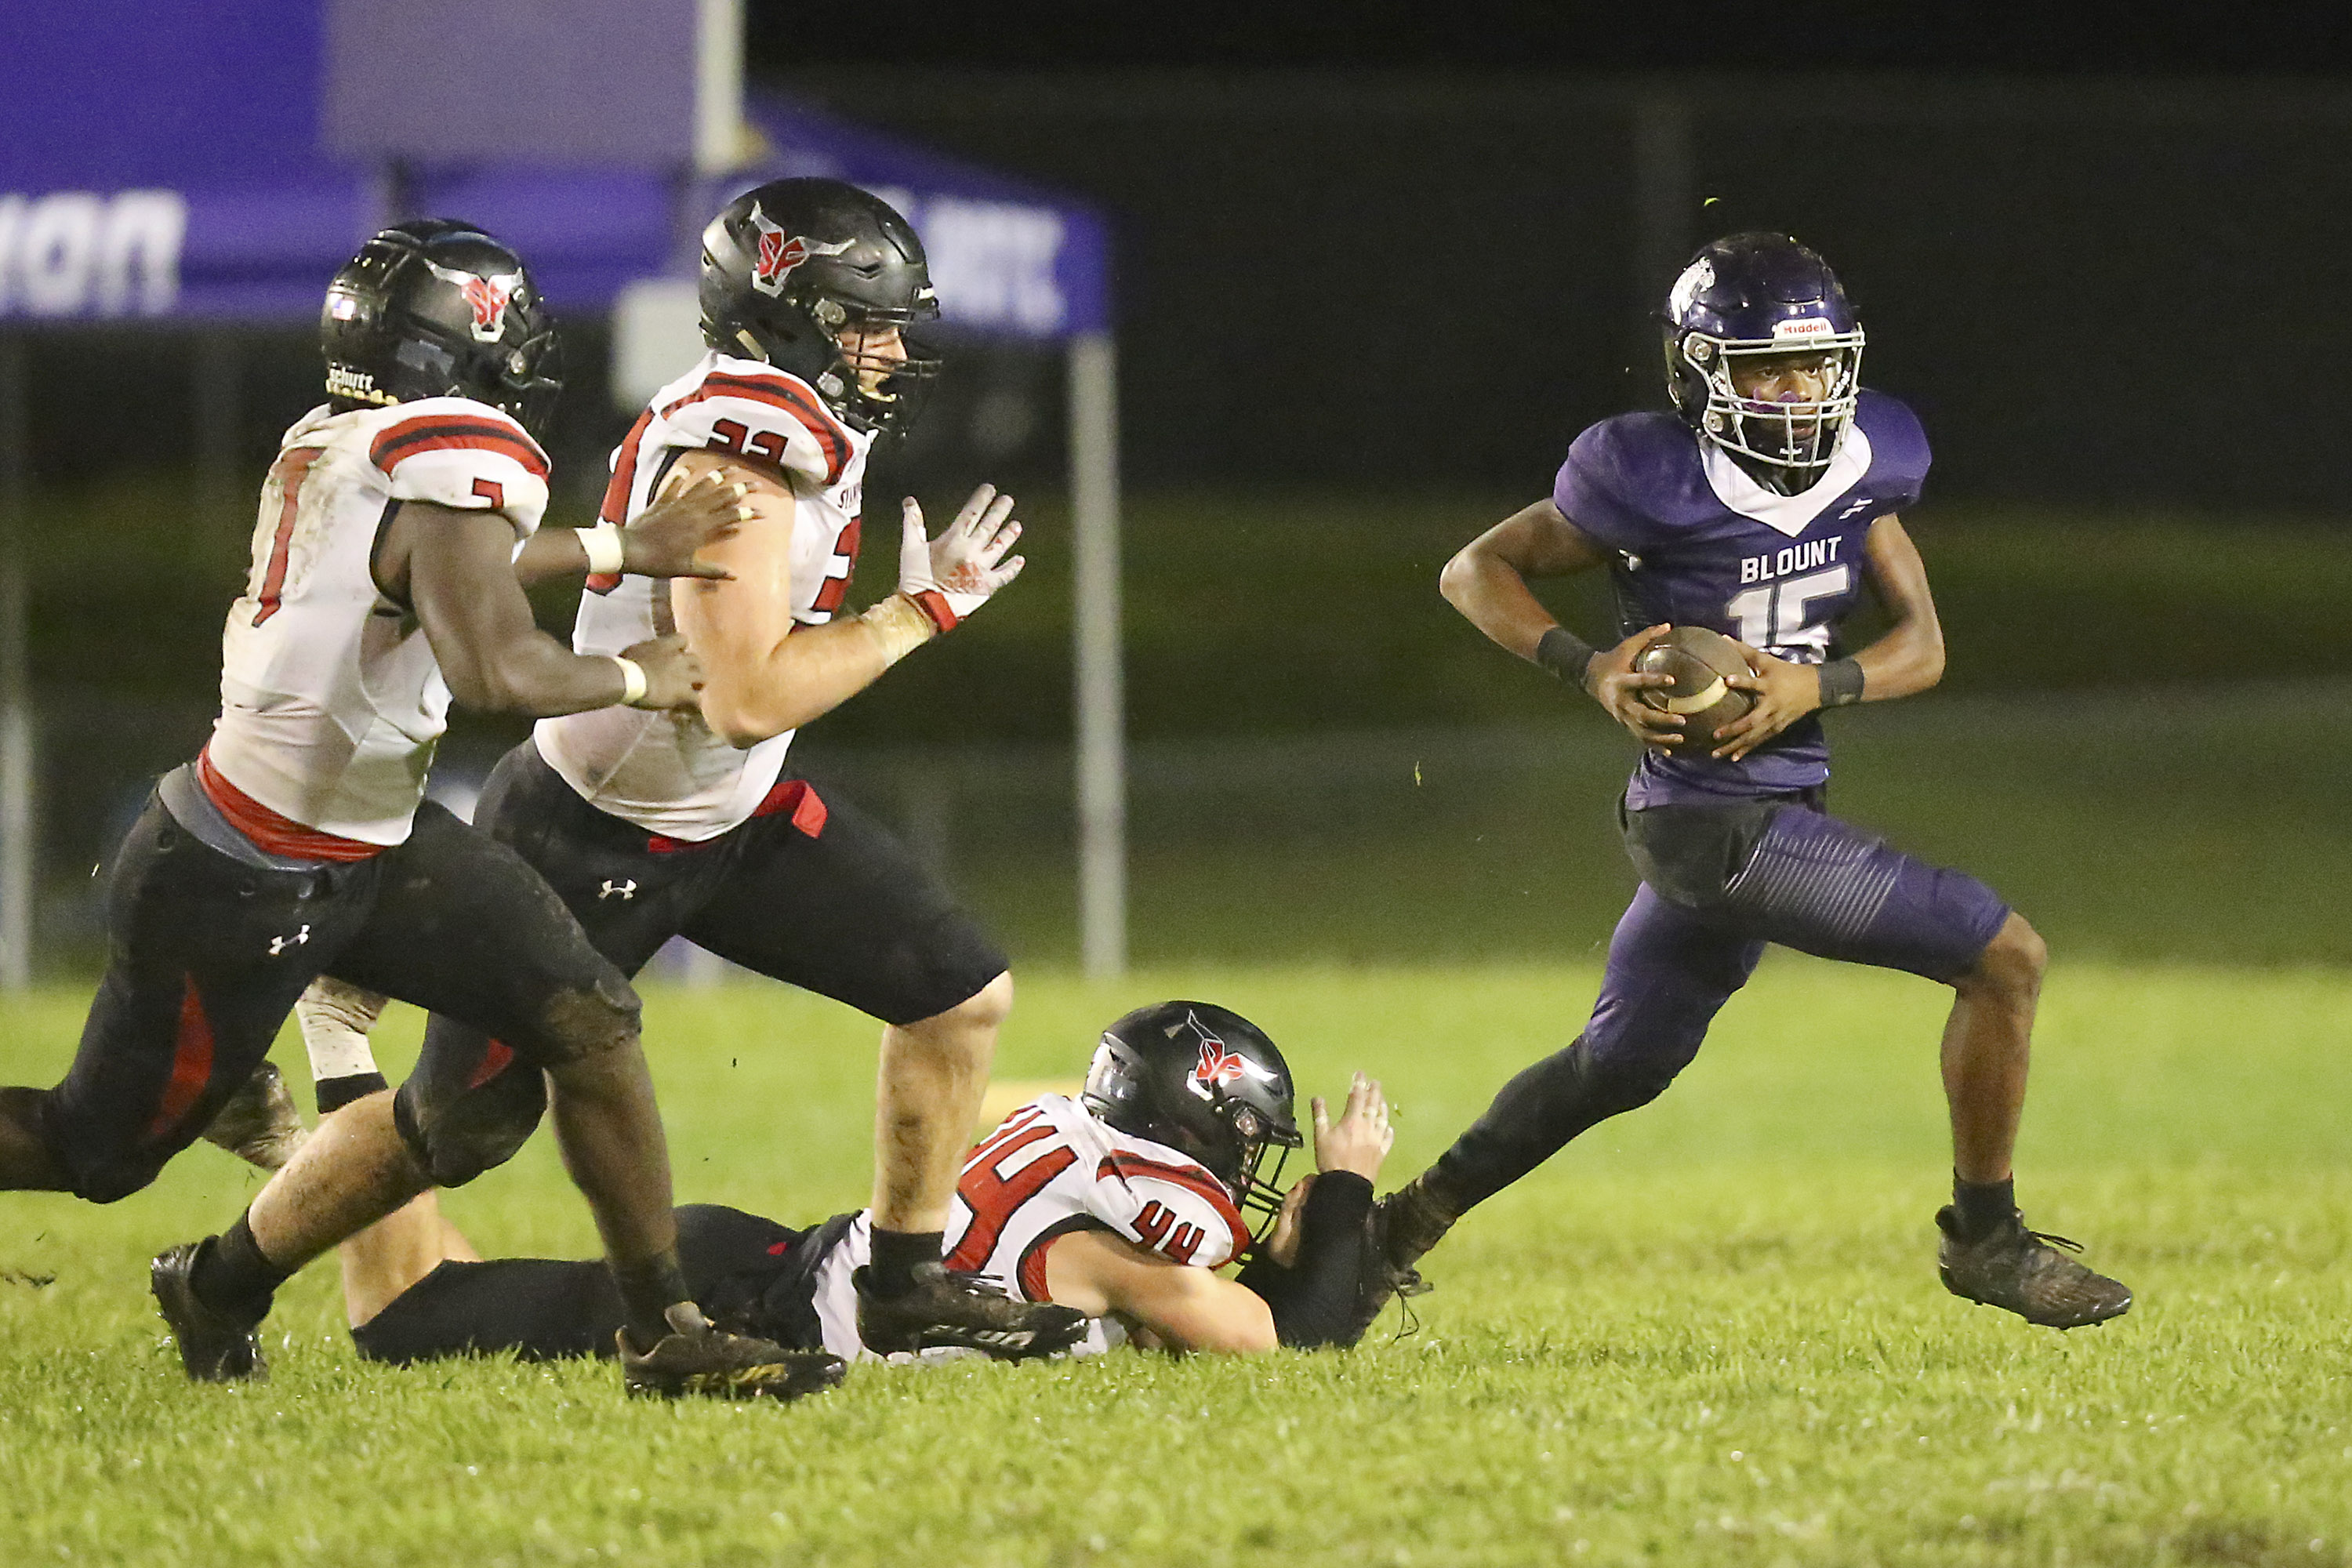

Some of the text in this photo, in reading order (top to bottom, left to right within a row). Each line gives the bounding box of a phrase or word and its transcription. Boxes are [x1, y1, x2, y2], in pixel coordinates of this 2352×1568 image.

[1784, 322, 1827, 335] Riddell
[1740, 535, 1842, 584] BLOUNT
[1726, 564, 1850, 657] 15
[1130, 1200, 1206, 1265] 44
